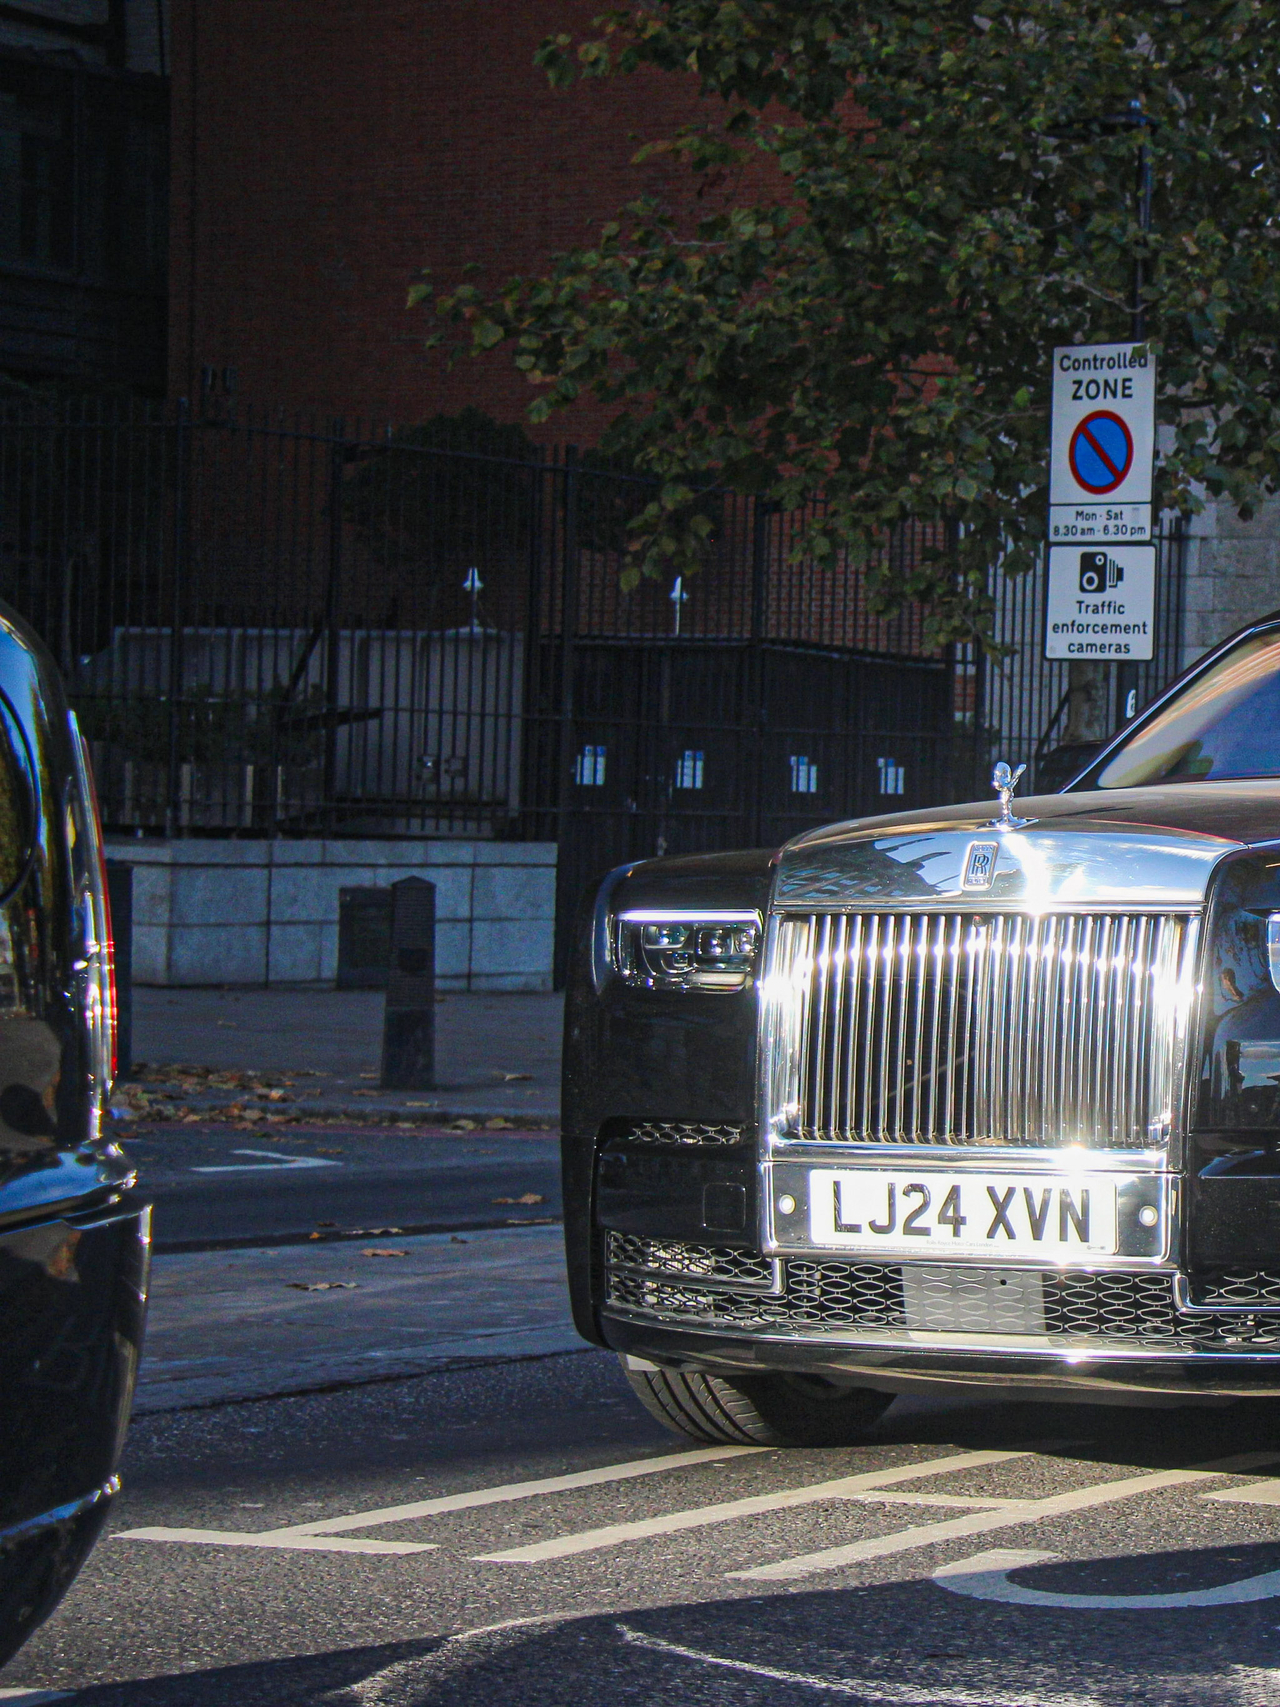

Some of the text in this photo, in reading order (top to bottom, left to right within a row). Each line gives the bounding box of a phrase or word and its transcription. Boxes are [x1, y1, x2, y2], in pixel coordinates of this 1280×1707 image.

[1059, 352, 1148, 372] Controlled
[1071, 377, 1133, 400] ZONE
[1075, 510, 1097, 522] Mon
[1105, 509, 1124, 521] Sat
[1053, 525, 1078, 536] 8.30
[1080, 528, 1095, 536] am
[1103, 524, 1127, 536] 6.30
[1130, 527, 1146, 537] pm
[1076, 600, 1125, 615] Traffic
[1052, 620, 1148, 634] enforcement
[1067, 643, 1130, 654] cameras
[833, 1179, 1091, 1243] LJ24 XVN
